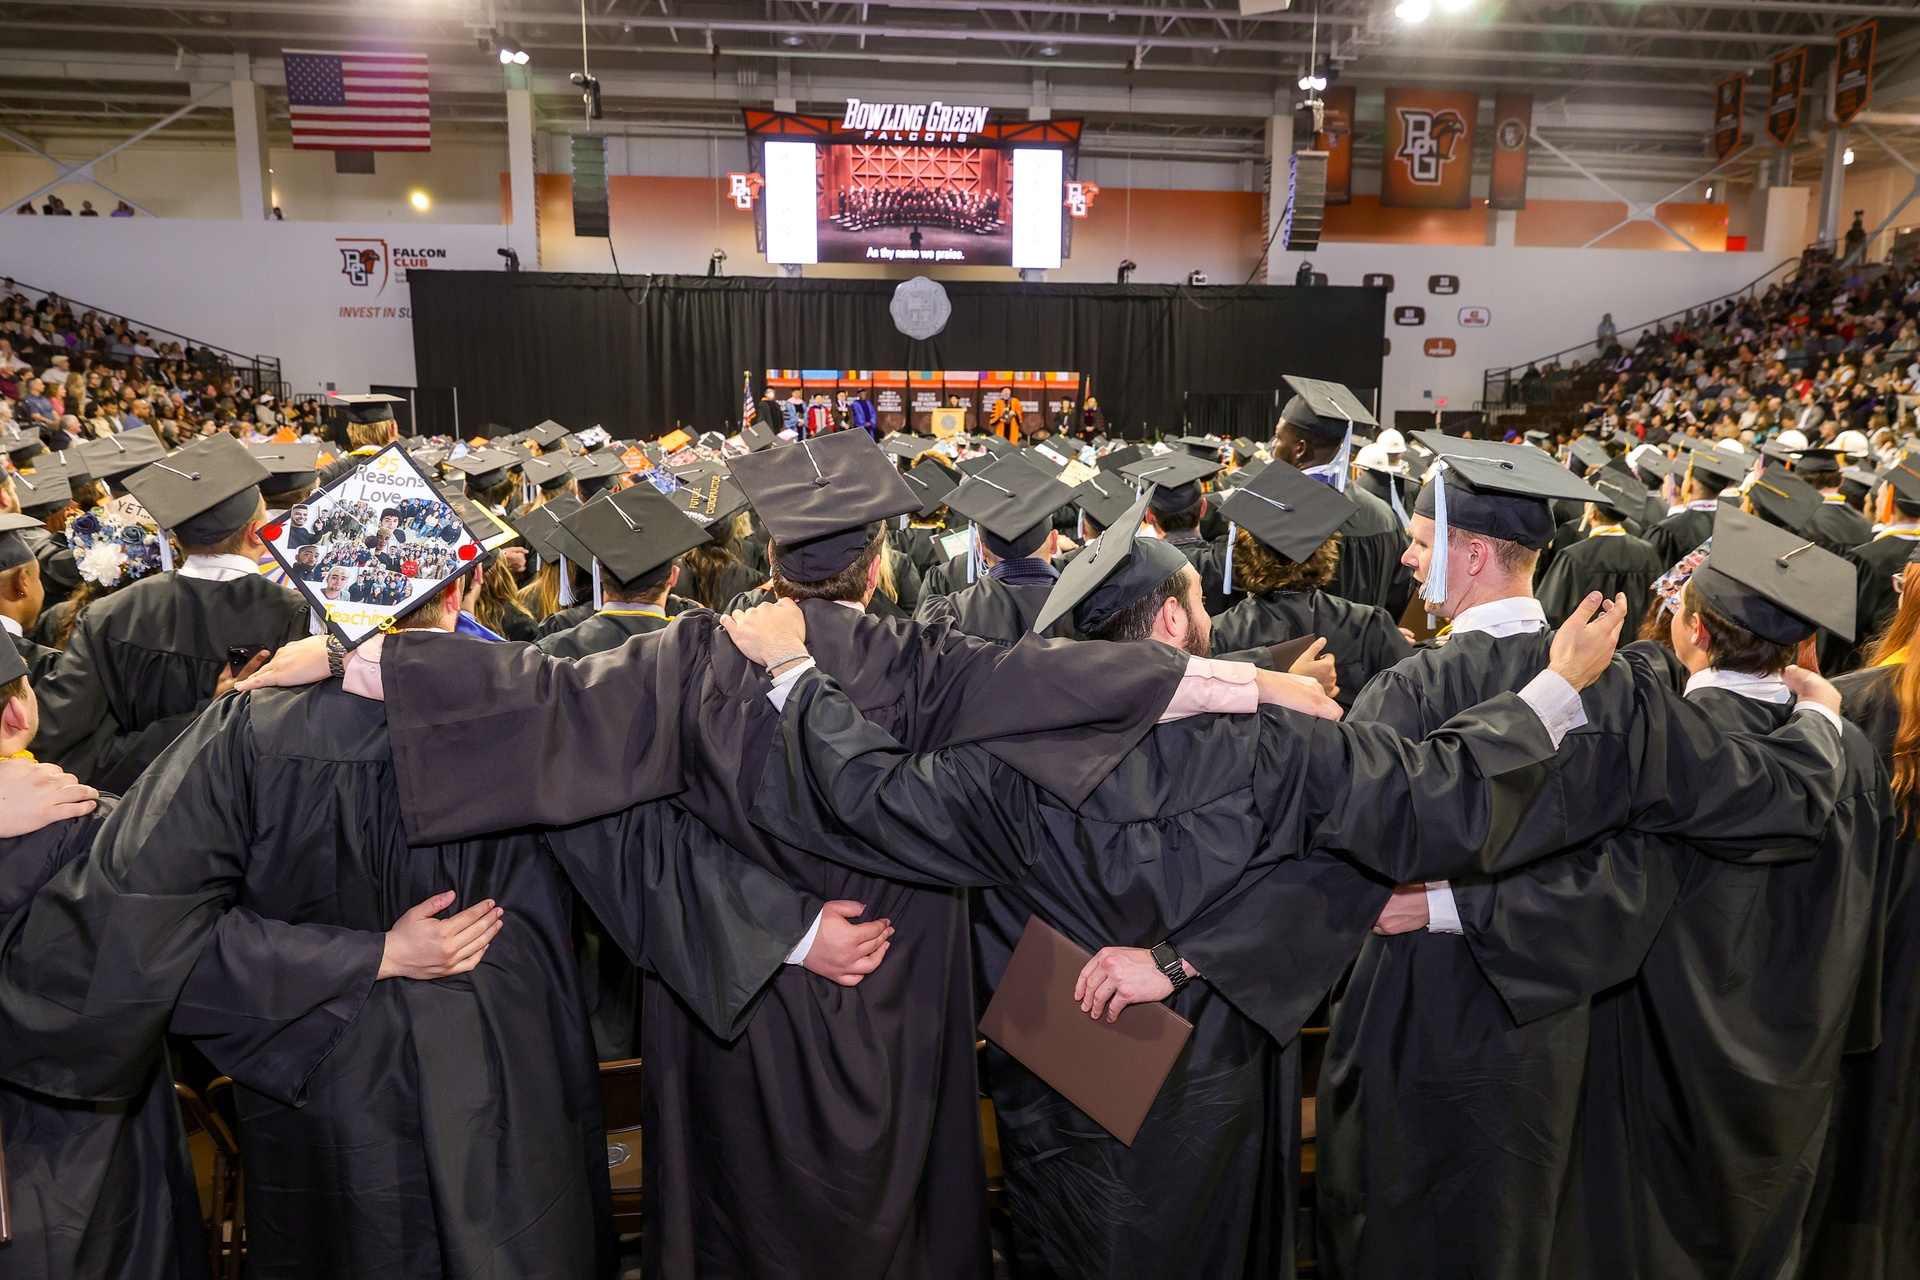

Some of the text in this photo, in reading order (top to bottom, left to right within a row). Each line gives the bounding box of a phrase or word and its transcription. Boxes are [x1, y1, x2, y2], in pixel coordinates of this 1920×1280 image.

[864, 130, 968, 142] FALCONS
[393, 248, 446, 258] FALCON
[866, 246, 879, 258] As
[880, 247, 895, 260] thy
[895, 249, 920, 259] name
[920, 249, 935, 259] we
[393, 258, 428, 267] CLUB
[339, 307, 381, 318] INVEST
[383, 307, 396, 318] IN
[376, 455, 400, 473] 95
[353, 465, 425, 488] Reasons
[360, 484, 402, 504] Love
[323, 603, 397, 631] Teaching
